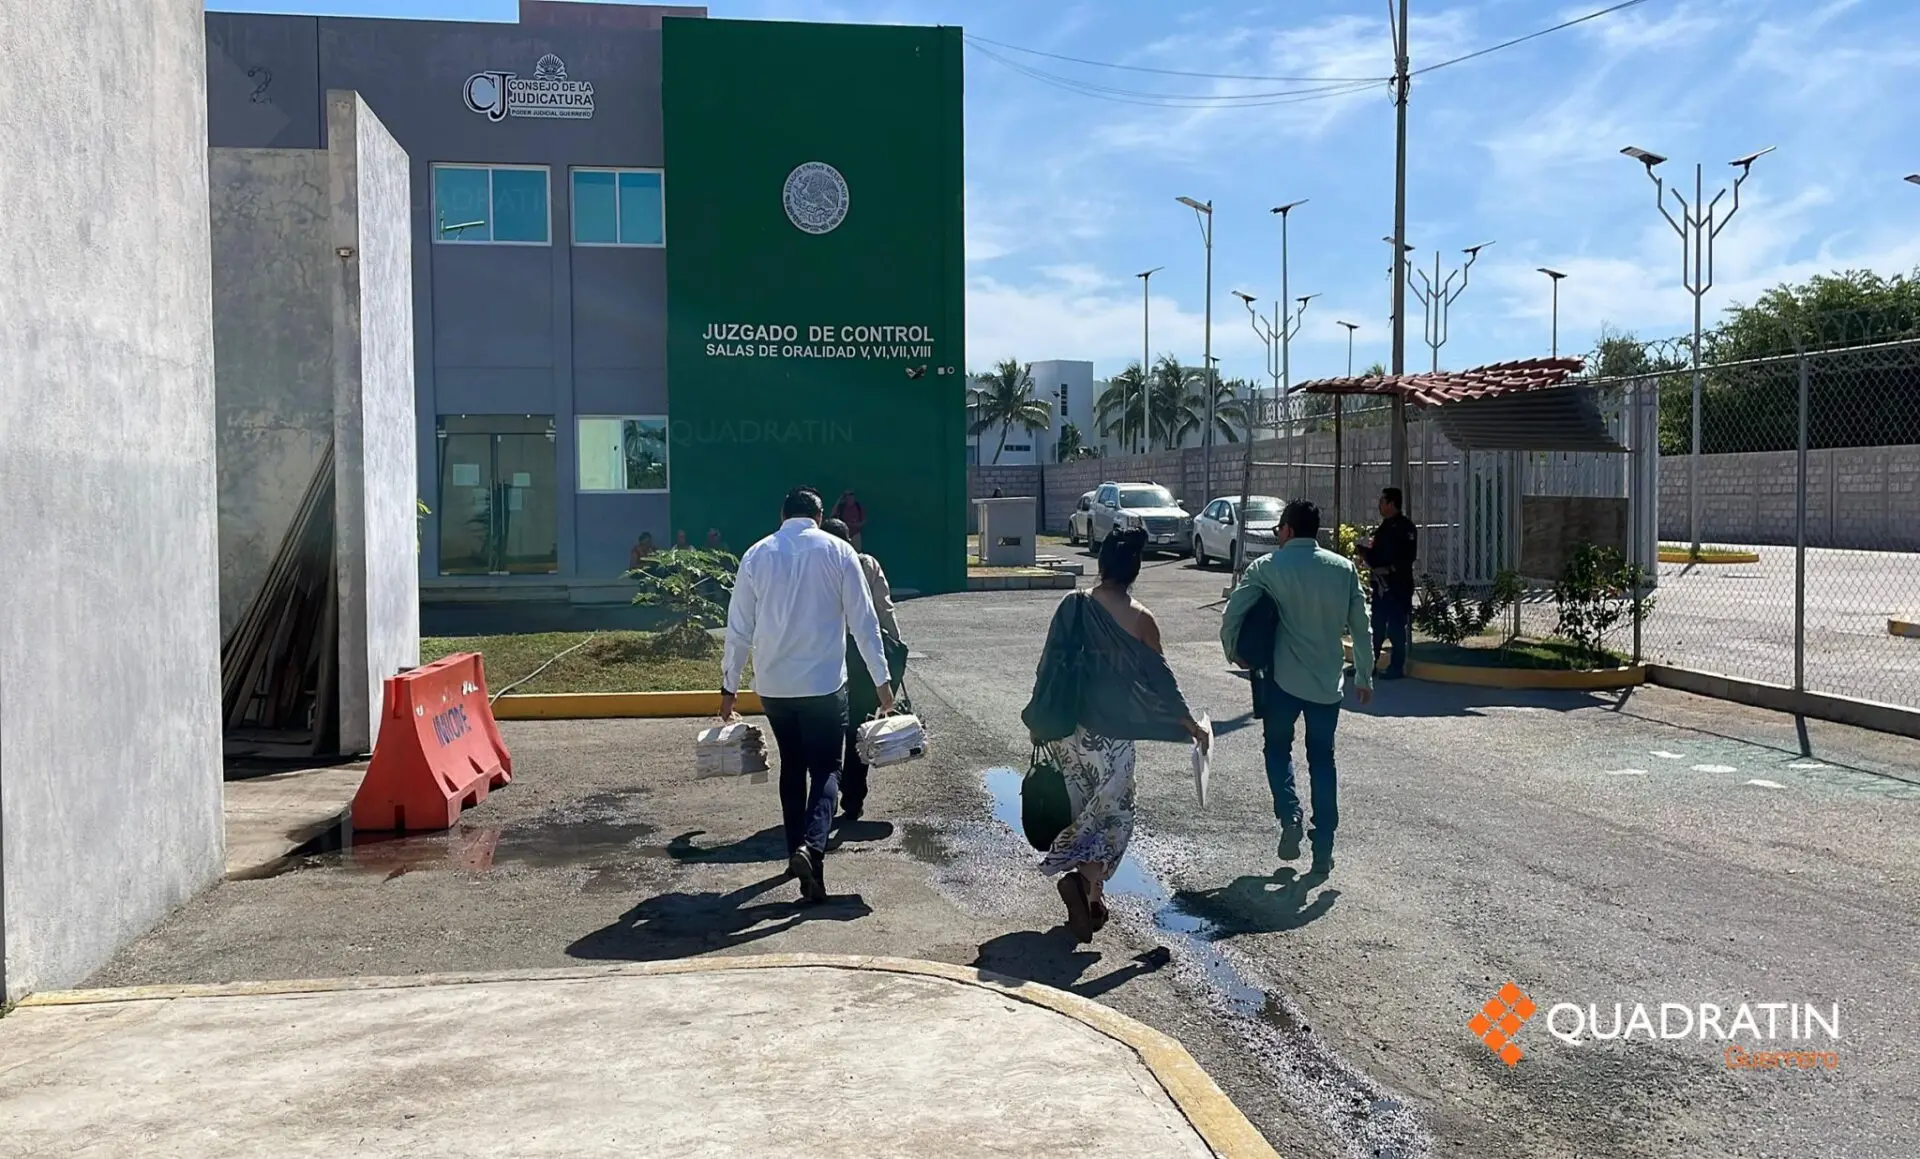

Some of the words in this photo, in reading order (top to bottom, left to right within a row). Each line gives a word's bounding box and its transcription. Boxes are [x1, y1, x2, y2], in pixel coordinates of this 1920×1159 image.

[509, 80, 559, 91] CONSEJO
[562, 82, 576, 92] DE
[578, 83, 593, 93] LA
[465, 71, 517, 120] CJ
[509, 92, 593, 106] JUDICATURA
[702, 323, 798, 342] JUZGADO
[808, 325, 835, 342] DE
[841, 325, 935, 342] CONTROL
[706, 344, 755, 358] SALAS
[758, 345, 778, 358] DE
[782, 345, 856, 358] ORALIDAD
[859, 345, 871, 360] V,
